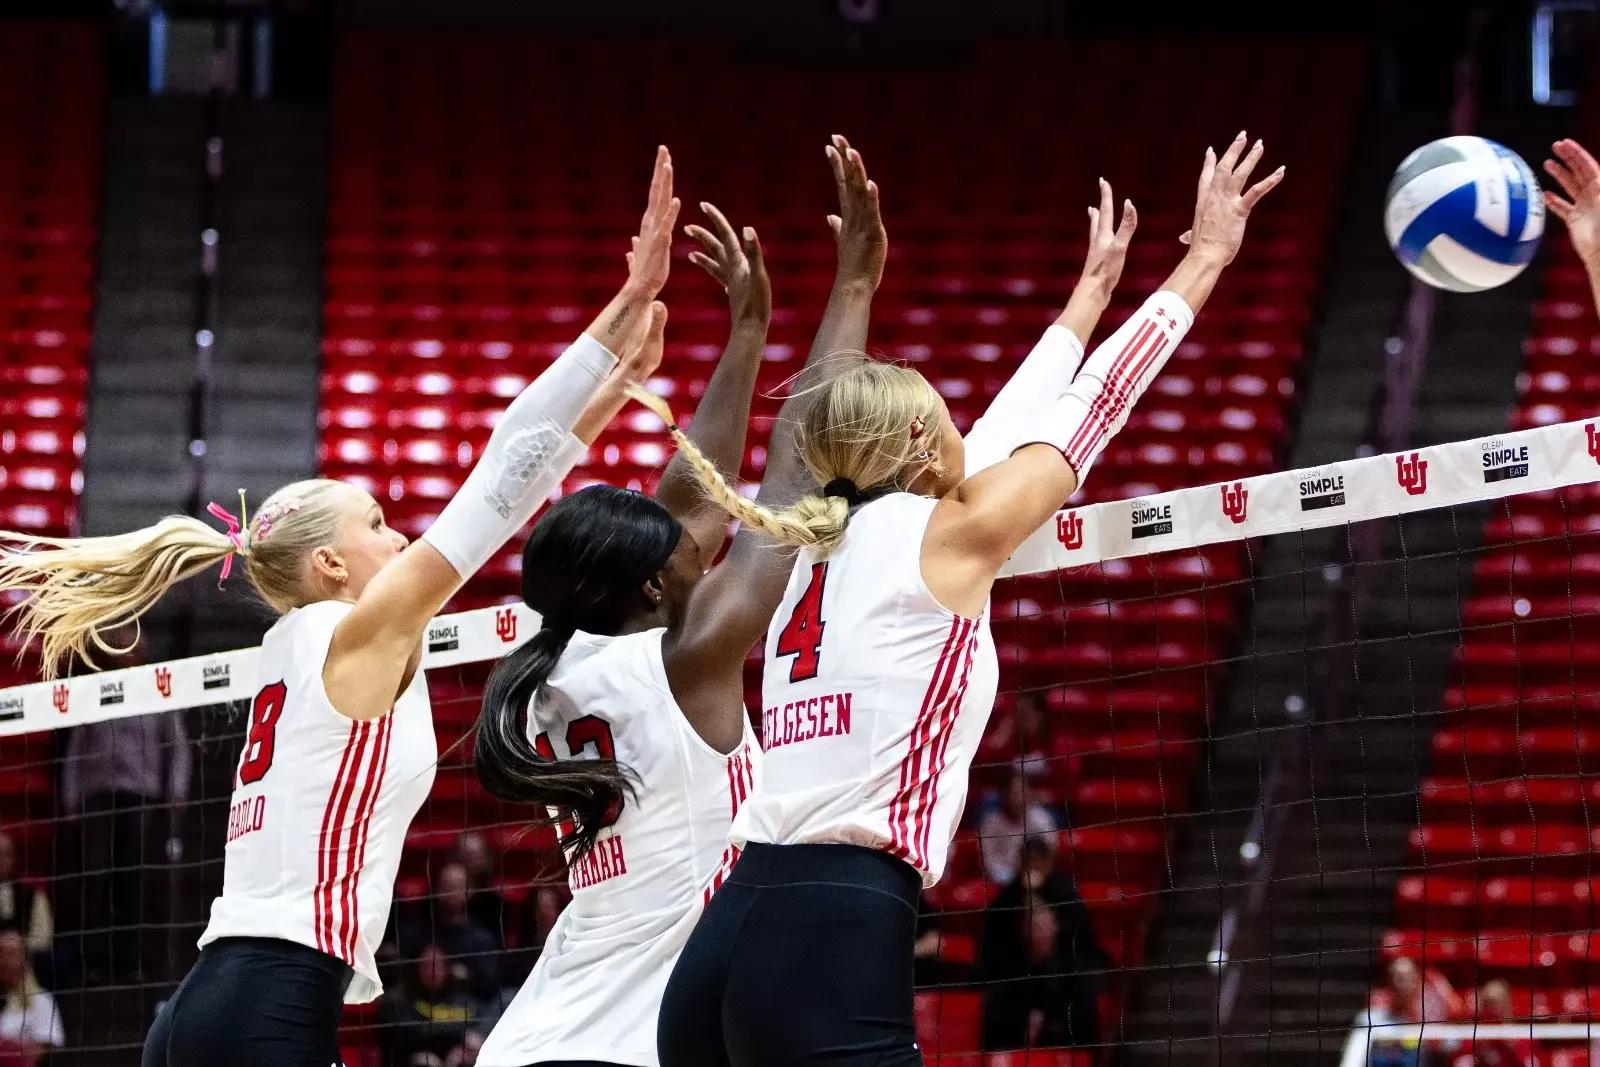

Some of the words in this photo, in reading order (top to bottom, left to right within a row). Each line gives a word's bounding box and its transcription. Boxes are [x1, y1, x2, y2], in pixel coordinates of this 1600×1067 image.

[1482, 440, 1504, 451] CLEAN
[1482, 446, 1528, 468] SIMPLE
[1509, 466, 1528, 477] EATS
[1300, 475, 1344, 496] SIMPLE
[1131, 504, 1172, 525] SIMPLE
[1153, 523, 1172, 533] EATS
[776, 561, 830, 684] 4
[428, 625, 459, 641] SIMPLE
[203, 664, 230, 678] SIMPLE
[232, 678, 287, 790] 8
